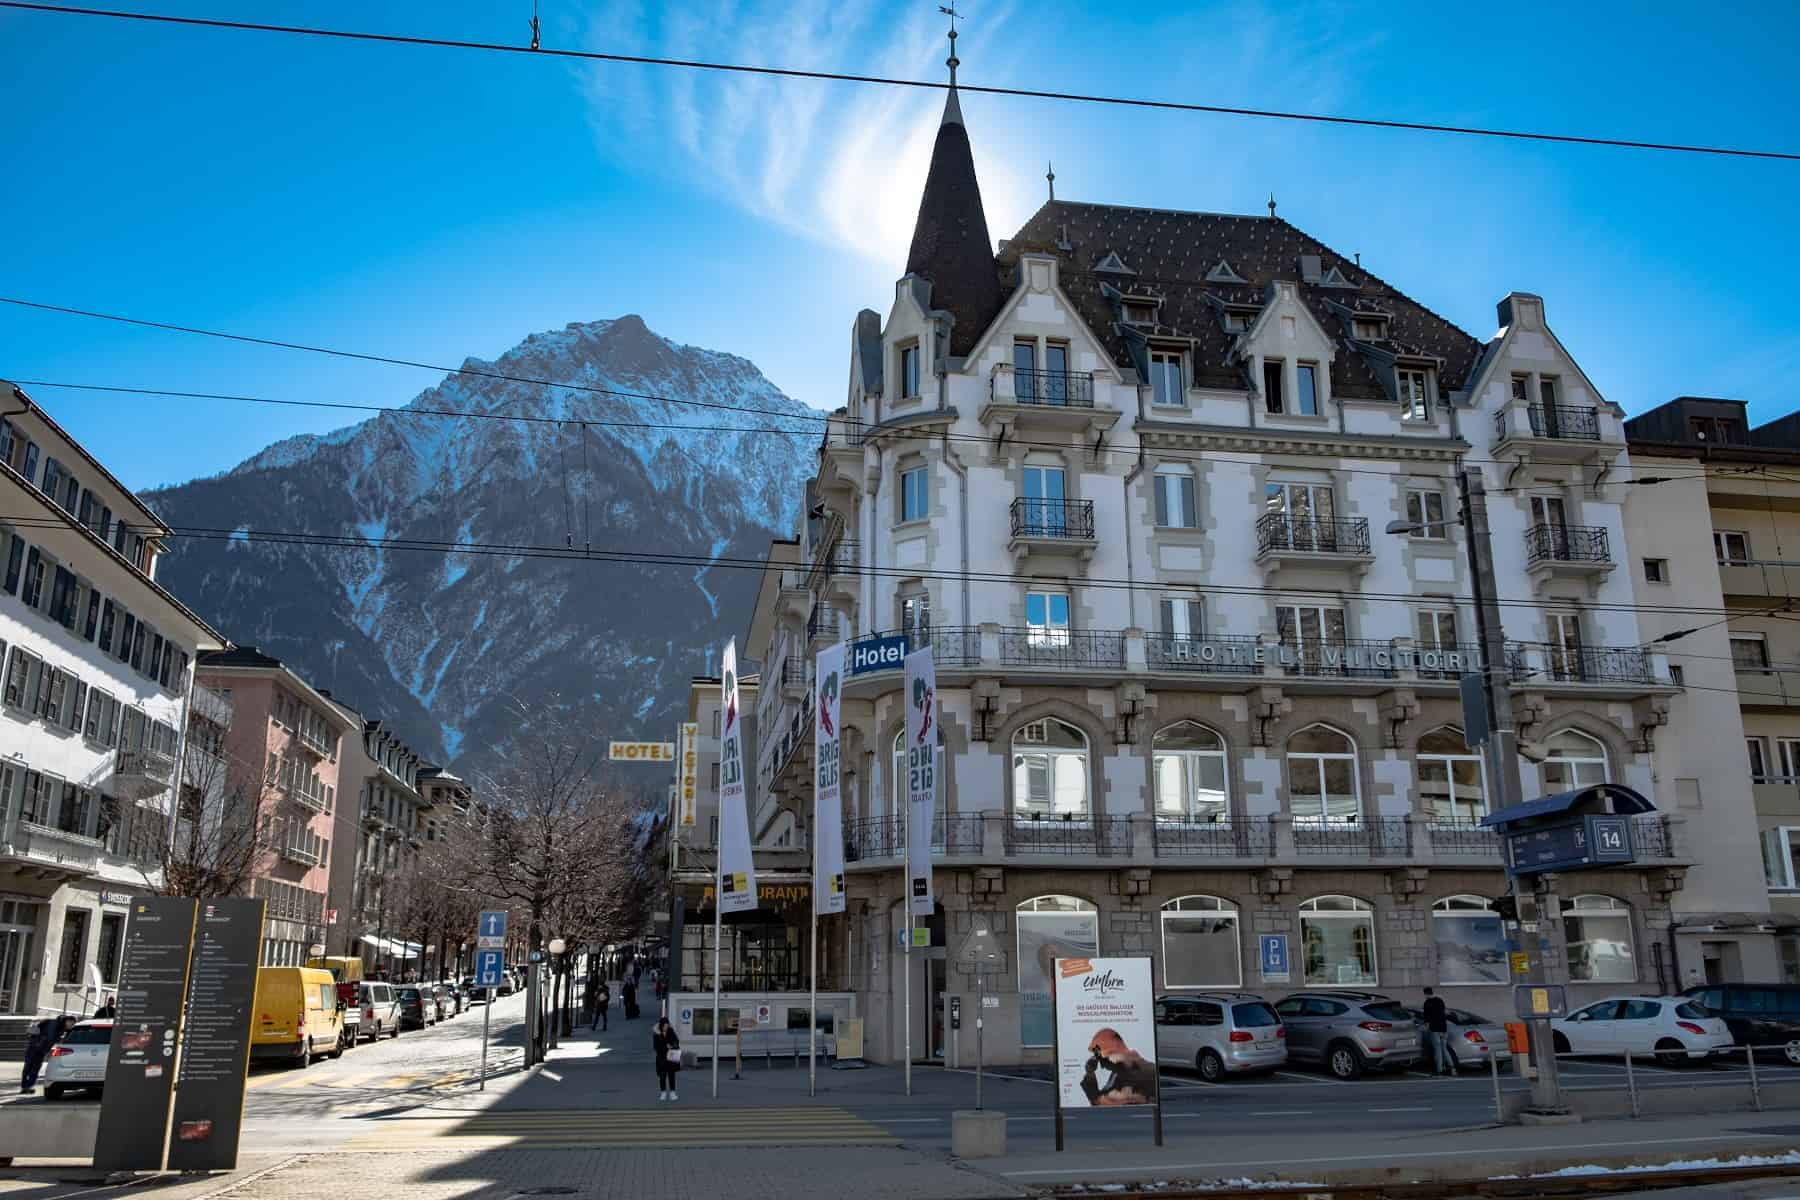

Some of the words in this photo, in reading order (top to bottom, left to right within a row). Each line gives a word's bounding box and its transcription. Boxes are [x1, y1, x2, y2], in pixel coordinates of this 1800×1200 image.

[855, 641, 905, 668] Hotel
[1176, 644, 1292, 665] HOTEL
[1323, 648, 1481, 668] VICTORI
[612, 744, 673, 759] HOTEL
[818, 739, 839, 766] BRIG
[1602, 831, 1621, 848] 14
[1269, 939, 1279, 954] P
[485, 953, 496, 970] P
